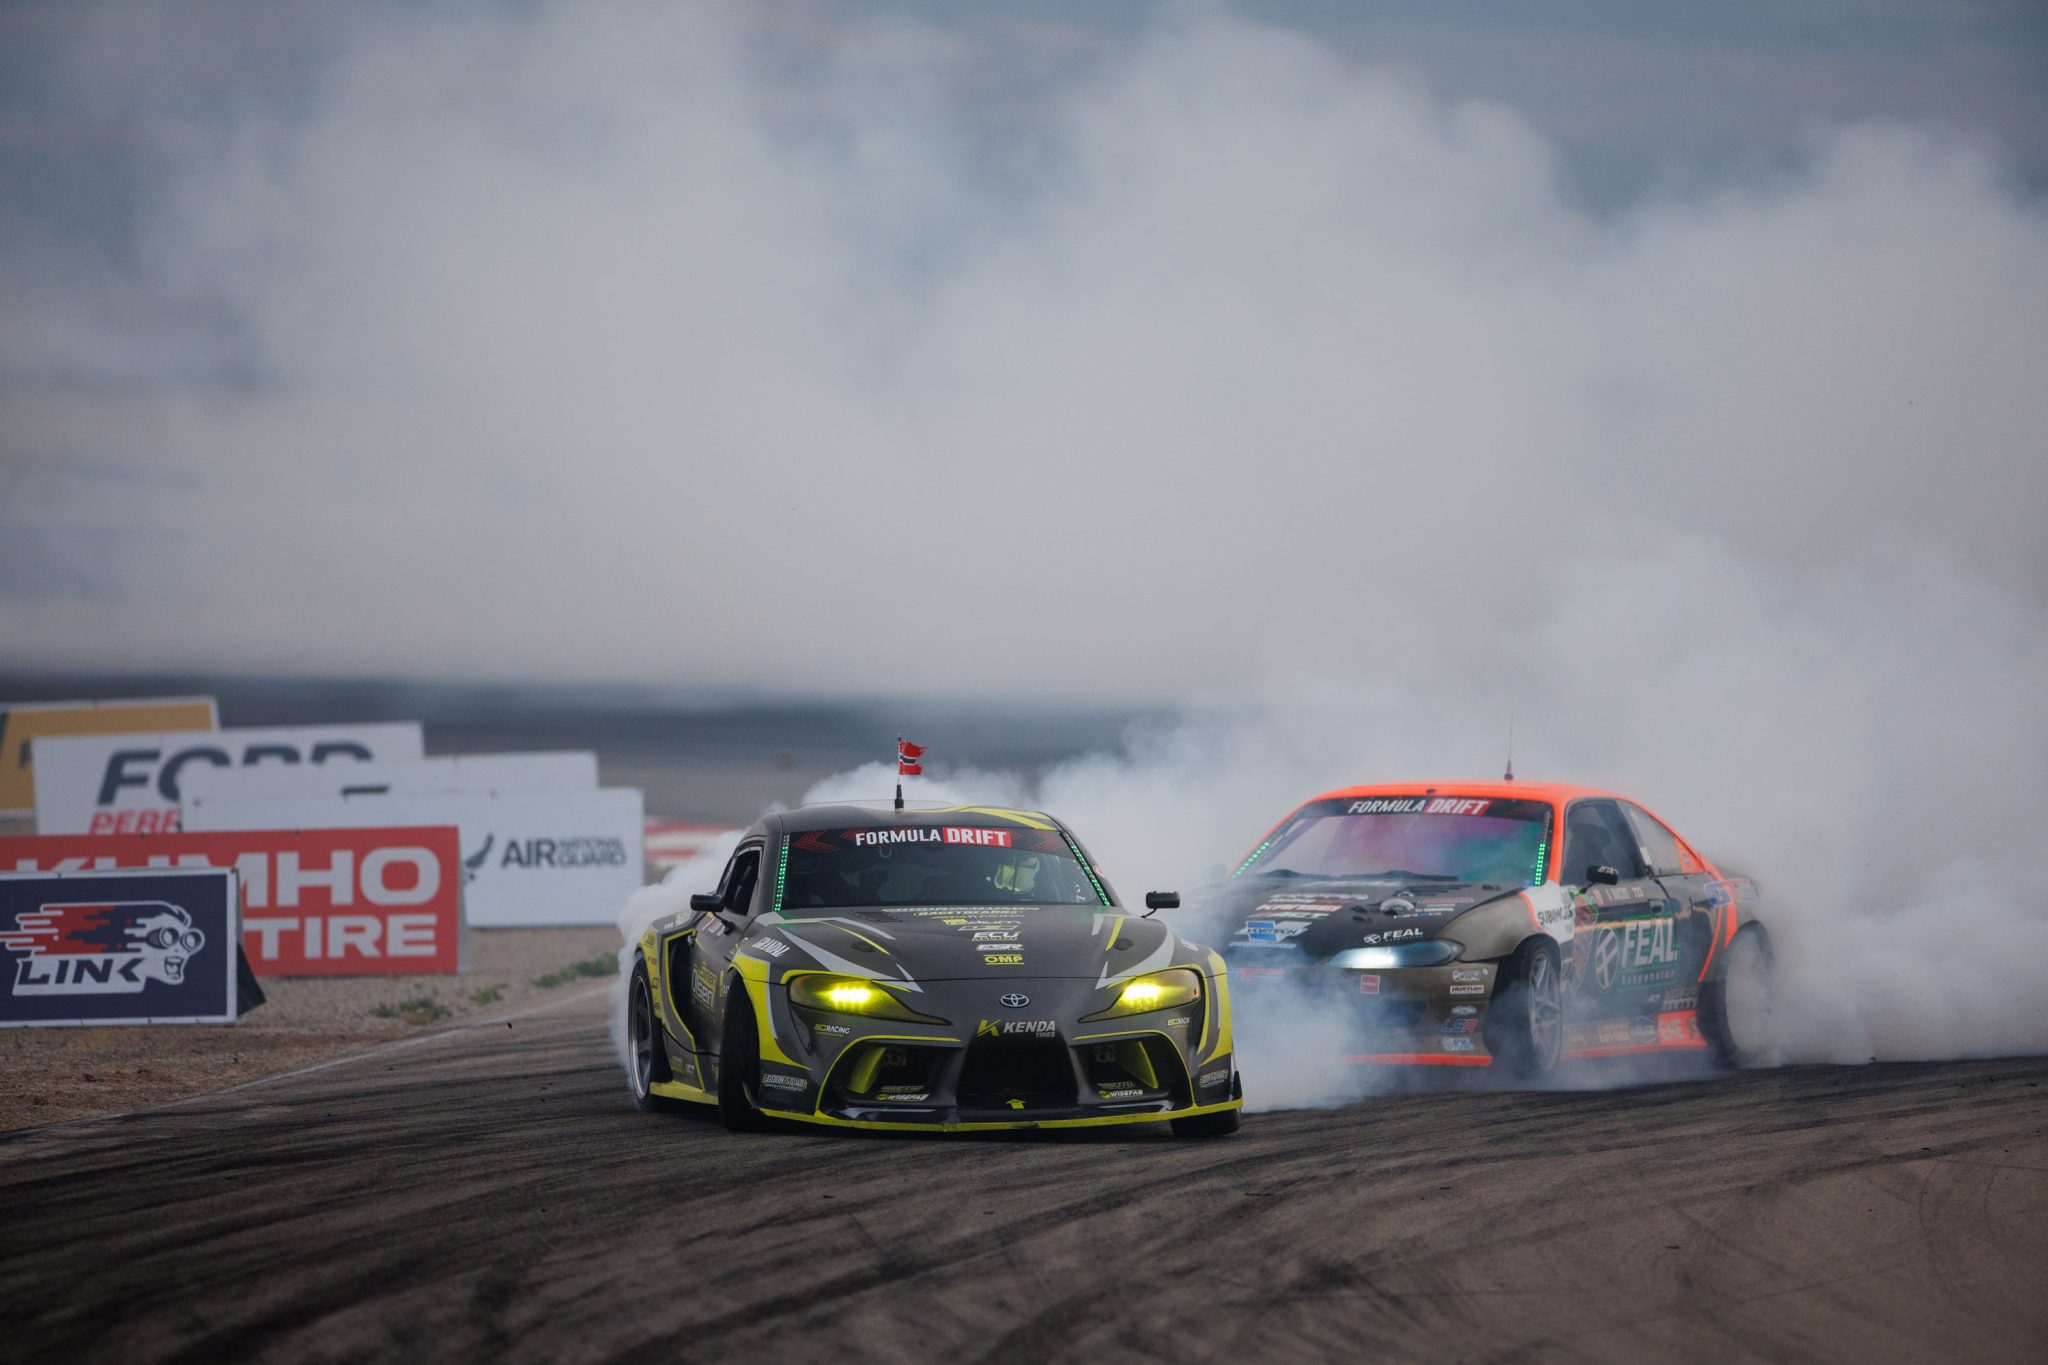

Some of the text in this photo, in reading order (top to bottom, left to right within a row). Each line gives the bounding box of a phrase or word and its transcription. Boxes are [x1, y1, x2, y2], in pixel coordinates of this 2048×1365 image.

[97, 740, 374, 805] FO
[1348, 799, 1489, 815] FORMULA DRIFT
[856, 828, 1006, 846] FORMULA DRIFT
[501, 837, 556, 868] AIR
[14, 845, 441, 909] MHO
[1383, 928, 1424, 941] FEAL
[1621, 917, 1678, 969] FEAL
[17, 957, 146, 986] LINK
[1003, 1020, 1056, 1033] KENDA
